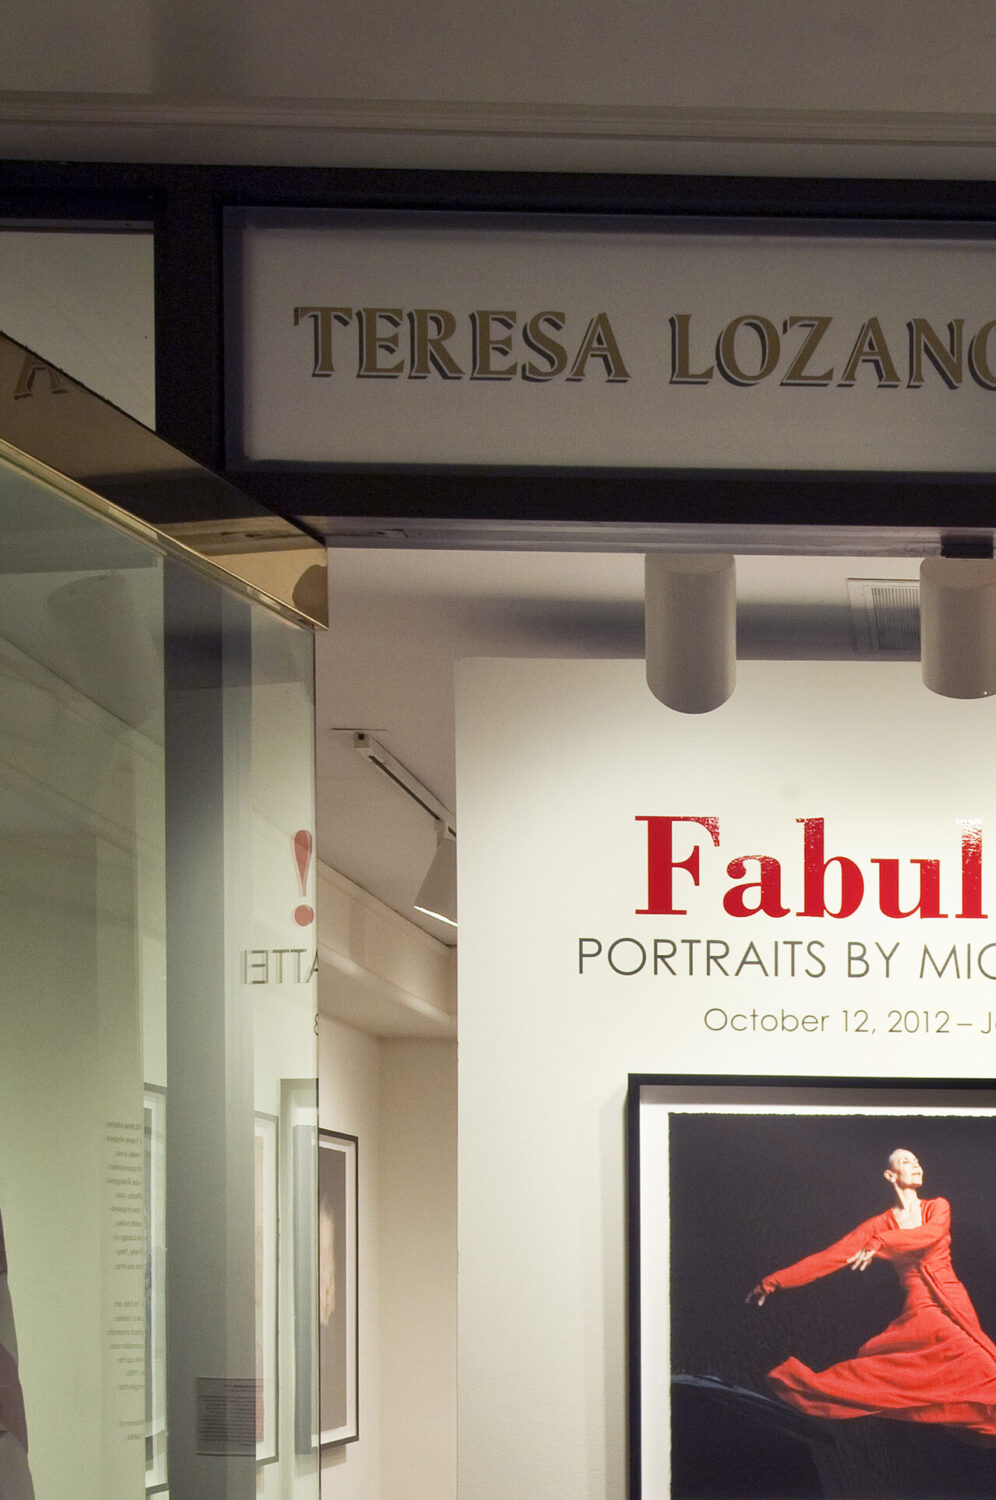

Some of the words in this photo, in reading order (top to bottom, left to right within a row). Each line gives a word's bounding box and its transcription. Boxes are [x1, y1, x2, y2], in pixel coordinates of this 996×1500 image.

[293, 306, 631, 383] TERESA
[578, 937, 826, 979] PORTRAITS
[847, 941, 900, 979] BY
[703, 1007, 830, 1033] October
[842, 1009, 877, 1035] 12,
